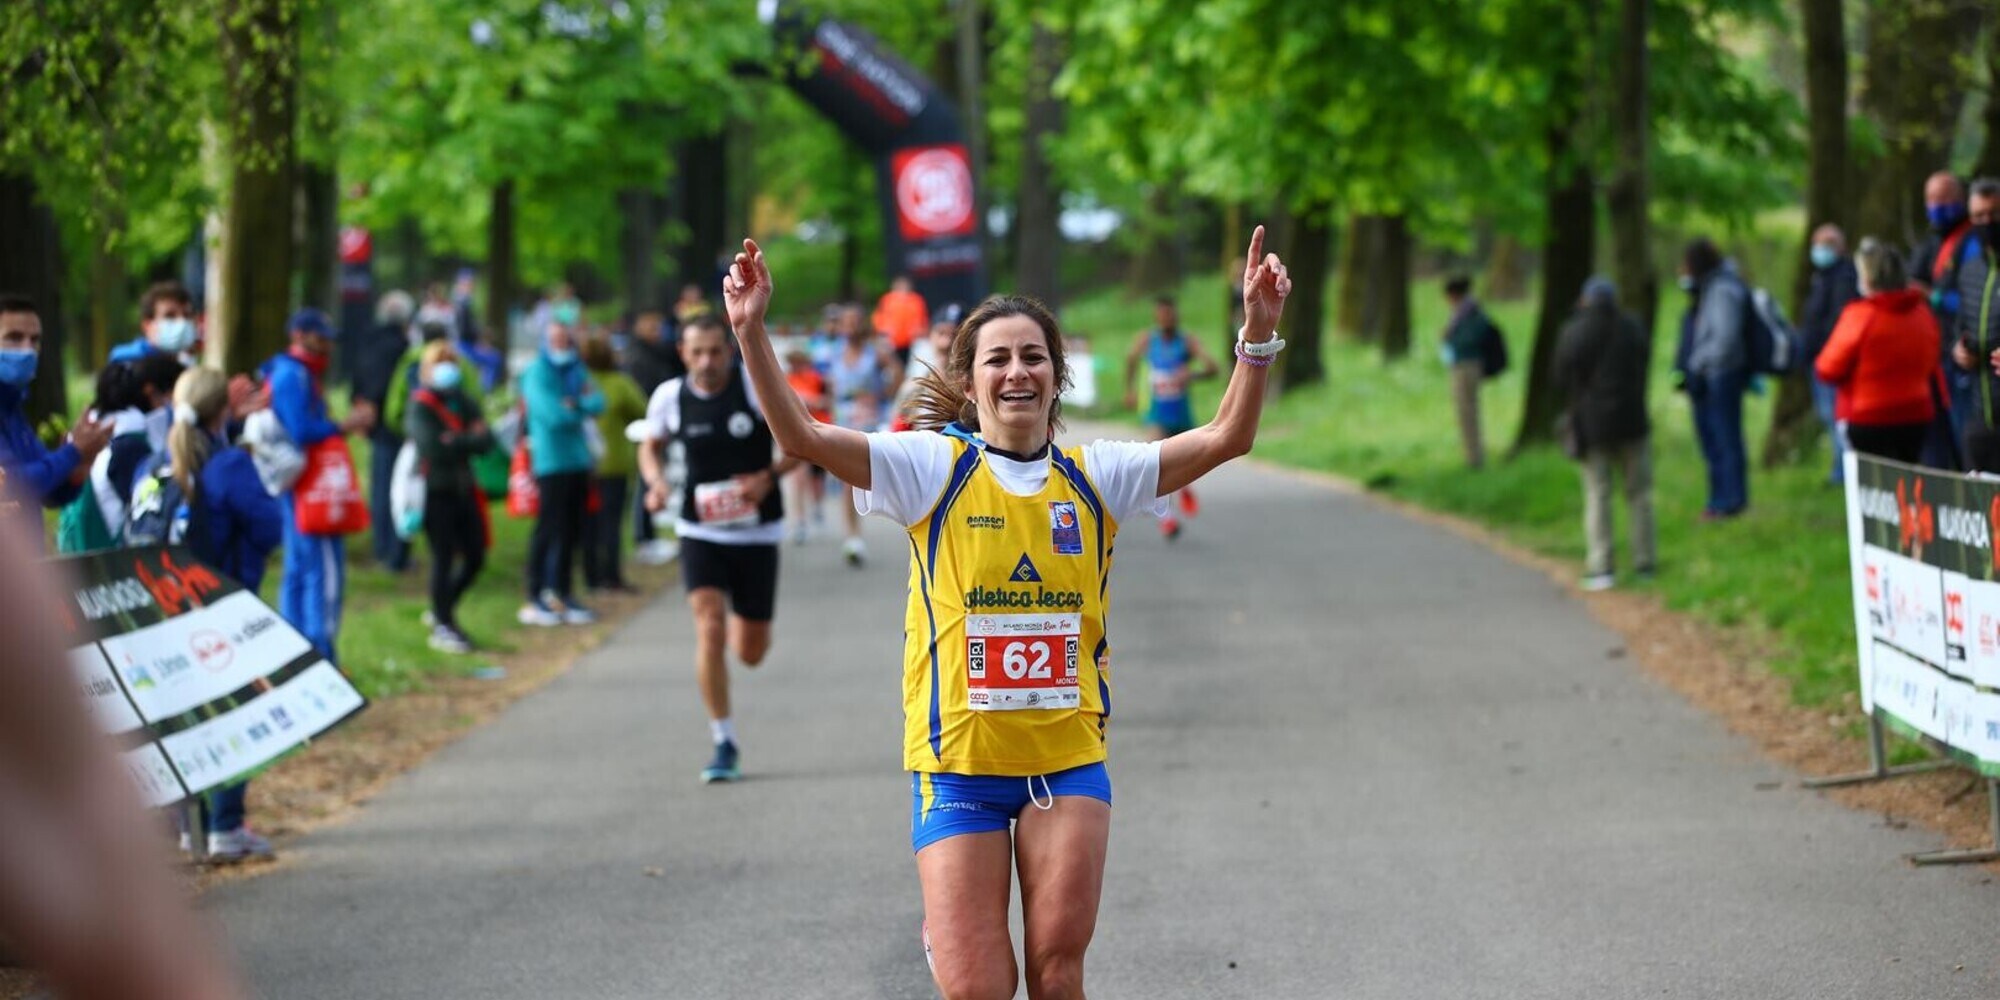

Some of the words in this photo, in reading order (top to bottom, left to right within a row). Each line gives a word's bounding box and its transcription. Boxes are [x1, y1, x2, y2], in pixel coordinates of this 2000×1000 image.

[964, 585, 1033, 608] atletica
[1035, 585, 1084, 608] lecco
[1002, 640, 1052, 680] 62
[1055, 677, 1078, 685] MONZA
